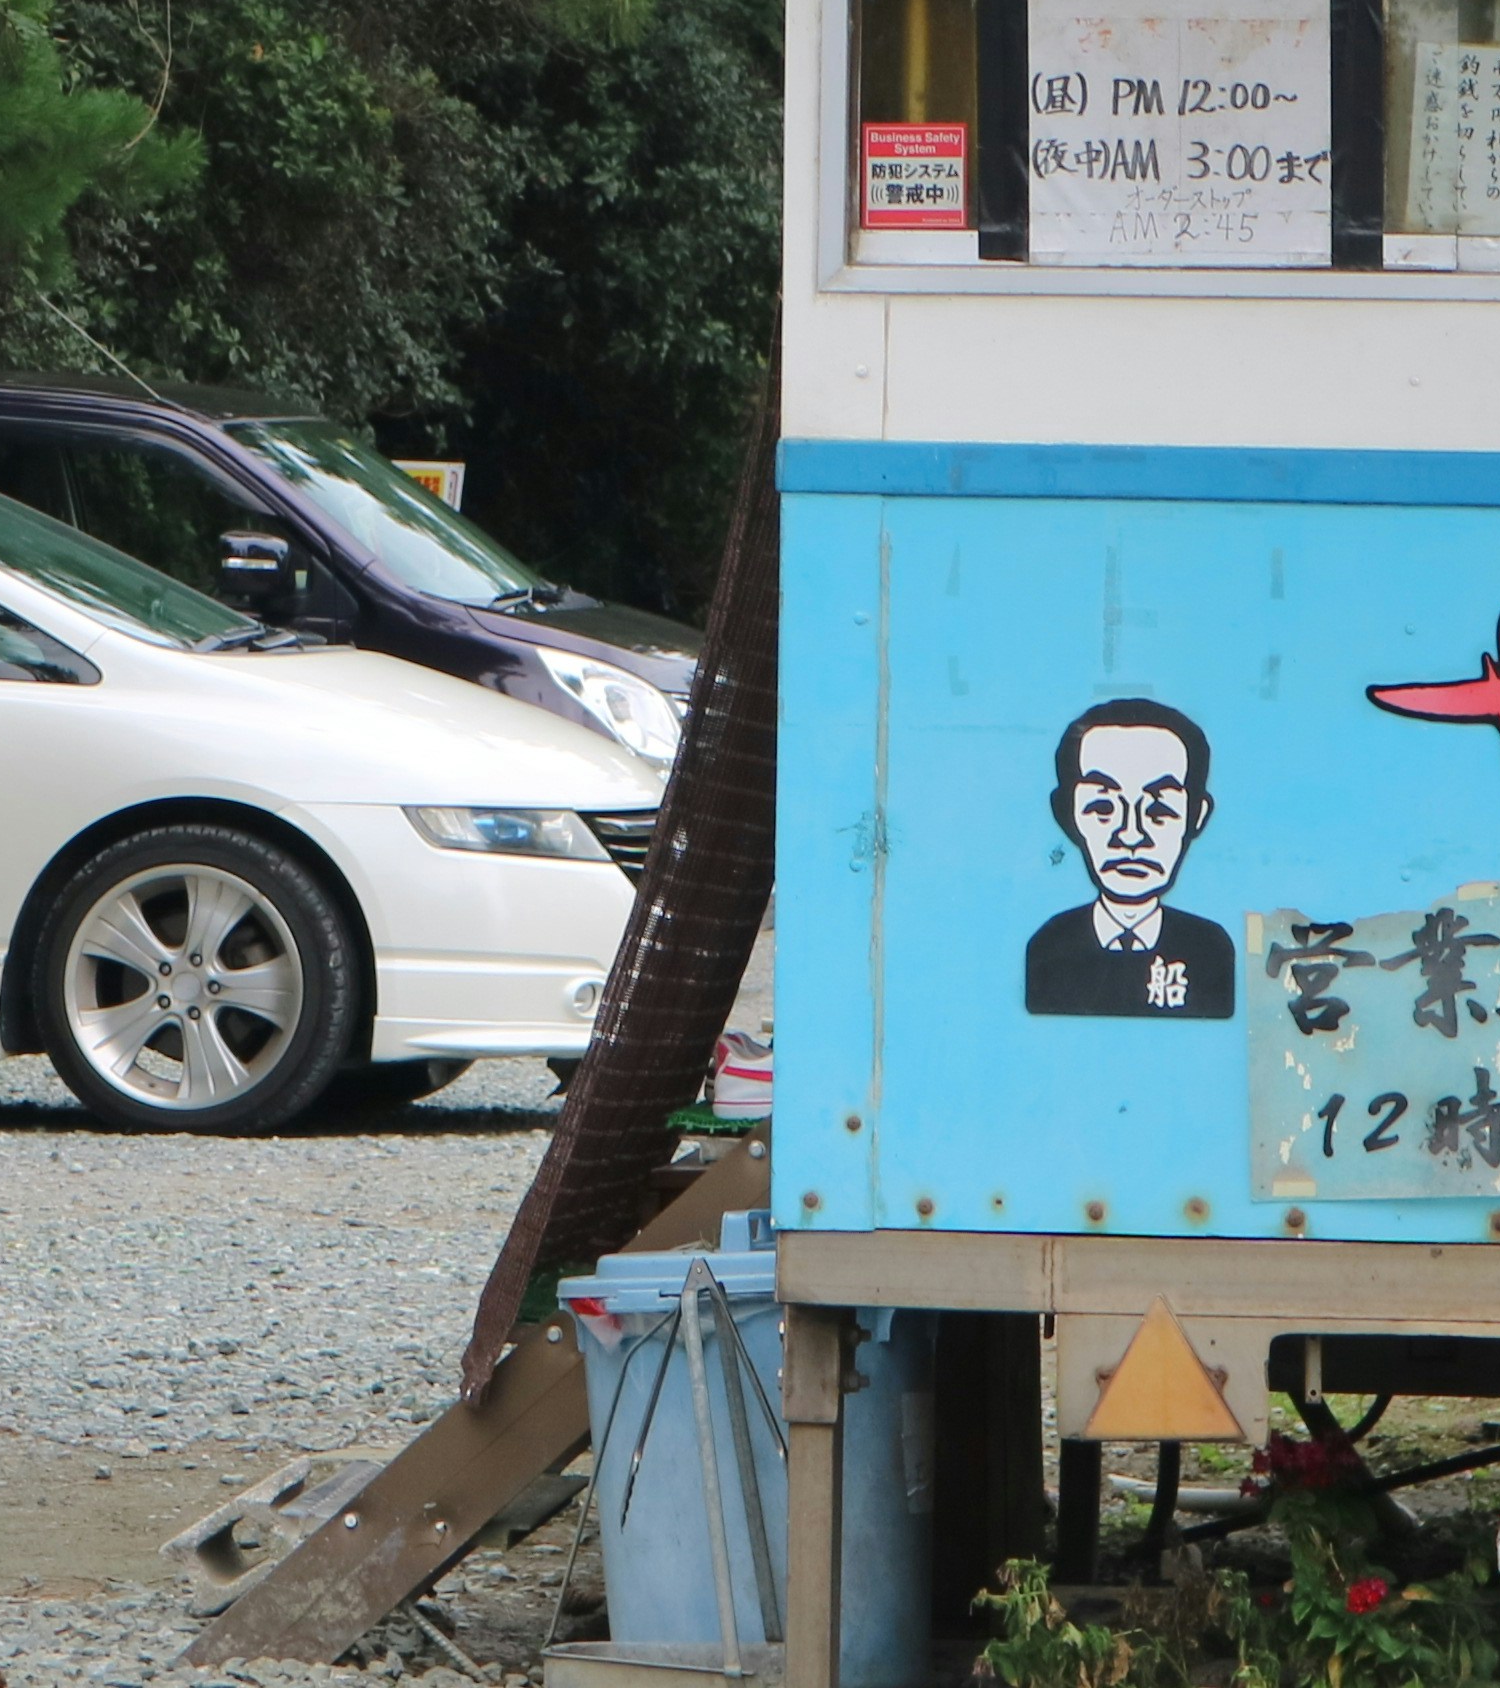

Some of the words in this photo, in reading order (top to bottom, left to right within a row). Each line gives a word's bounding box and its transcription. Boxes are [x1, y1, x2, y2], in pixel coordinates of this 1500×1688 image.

[1031, 72, 1088, 116] (昼)
[1112, 78, 1164, 116] PM
[871, 132, 922, 143] Business
[925, 132, 960, 145] Safety
[895, 144, 936, 156] System
[1418, 50, 1446, 229] ご迷惑おかけしてい
[1452, 54, 1481, 229] 釣銭を切らしてい
[871, 163, 960, 179] 防犯システム
[886, 183, 945, 205] 警戒中
[1126, 185, 1253, 210] オーダーストップ
[1109, 212, 1159, 243] AM
[1174, 213, 1259, 243] 2:45
[1146, 954, 1189, 1009] 船
